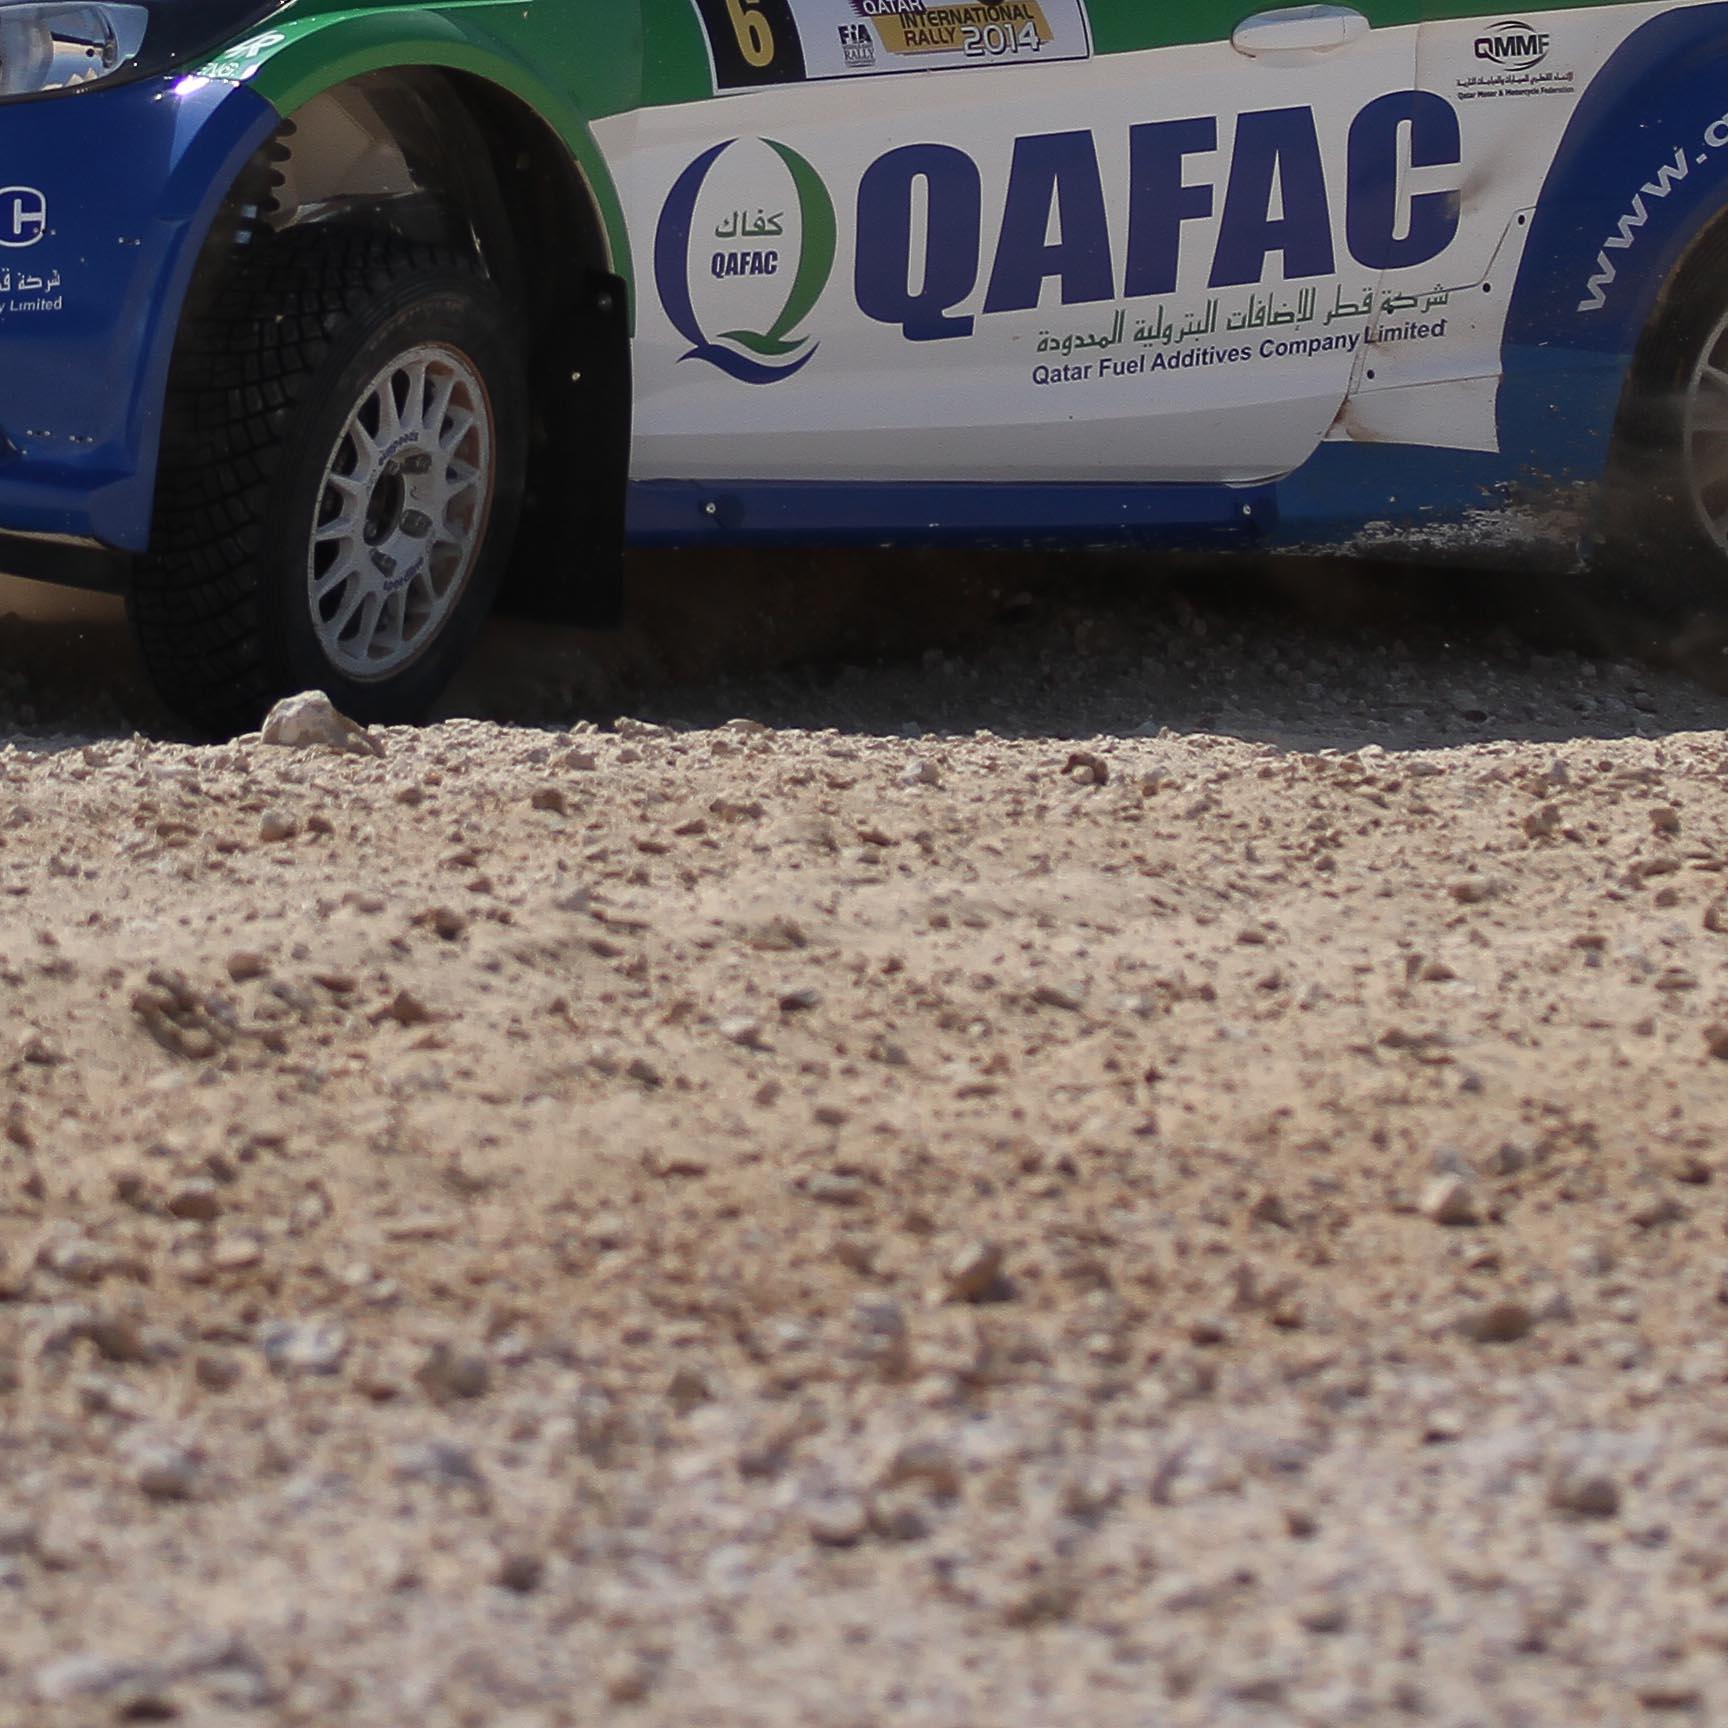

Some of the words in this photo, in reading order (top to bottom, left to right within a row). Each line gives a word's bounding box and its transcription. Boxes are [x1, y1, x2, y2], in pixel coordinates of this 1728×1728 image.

[899, 3, 1035, 29] INTERNATIONAL
[843, 48, 874, 61] RALLY
[903, 26, 957, 47] RALLY
[961, 20, 1042, 57] 2014
[1474, 34, 1550, 62] QMMF
[714, 209, 784, 240] كفاك
[853, 89, 1462, 343] QAFAC
[710, 250, 779, 278] QAFAC
[9, 295, 63, 312] Limited
[1322, 283, 1373, 326] قطر
[1379, 282, 1450, 315] شركة
[1035, 309, 1125, 358] المحدودة
[1133, 297, 1219, 349] البترولية
[1031, 361, 1092, 386] Qatar
[1098, 352, 1146, 377] Fuel
[1150, 339, 1252, 371] Additives
[1258, 329, 1361, 360] Company
[1363, 317, 1448, 346] Limited
